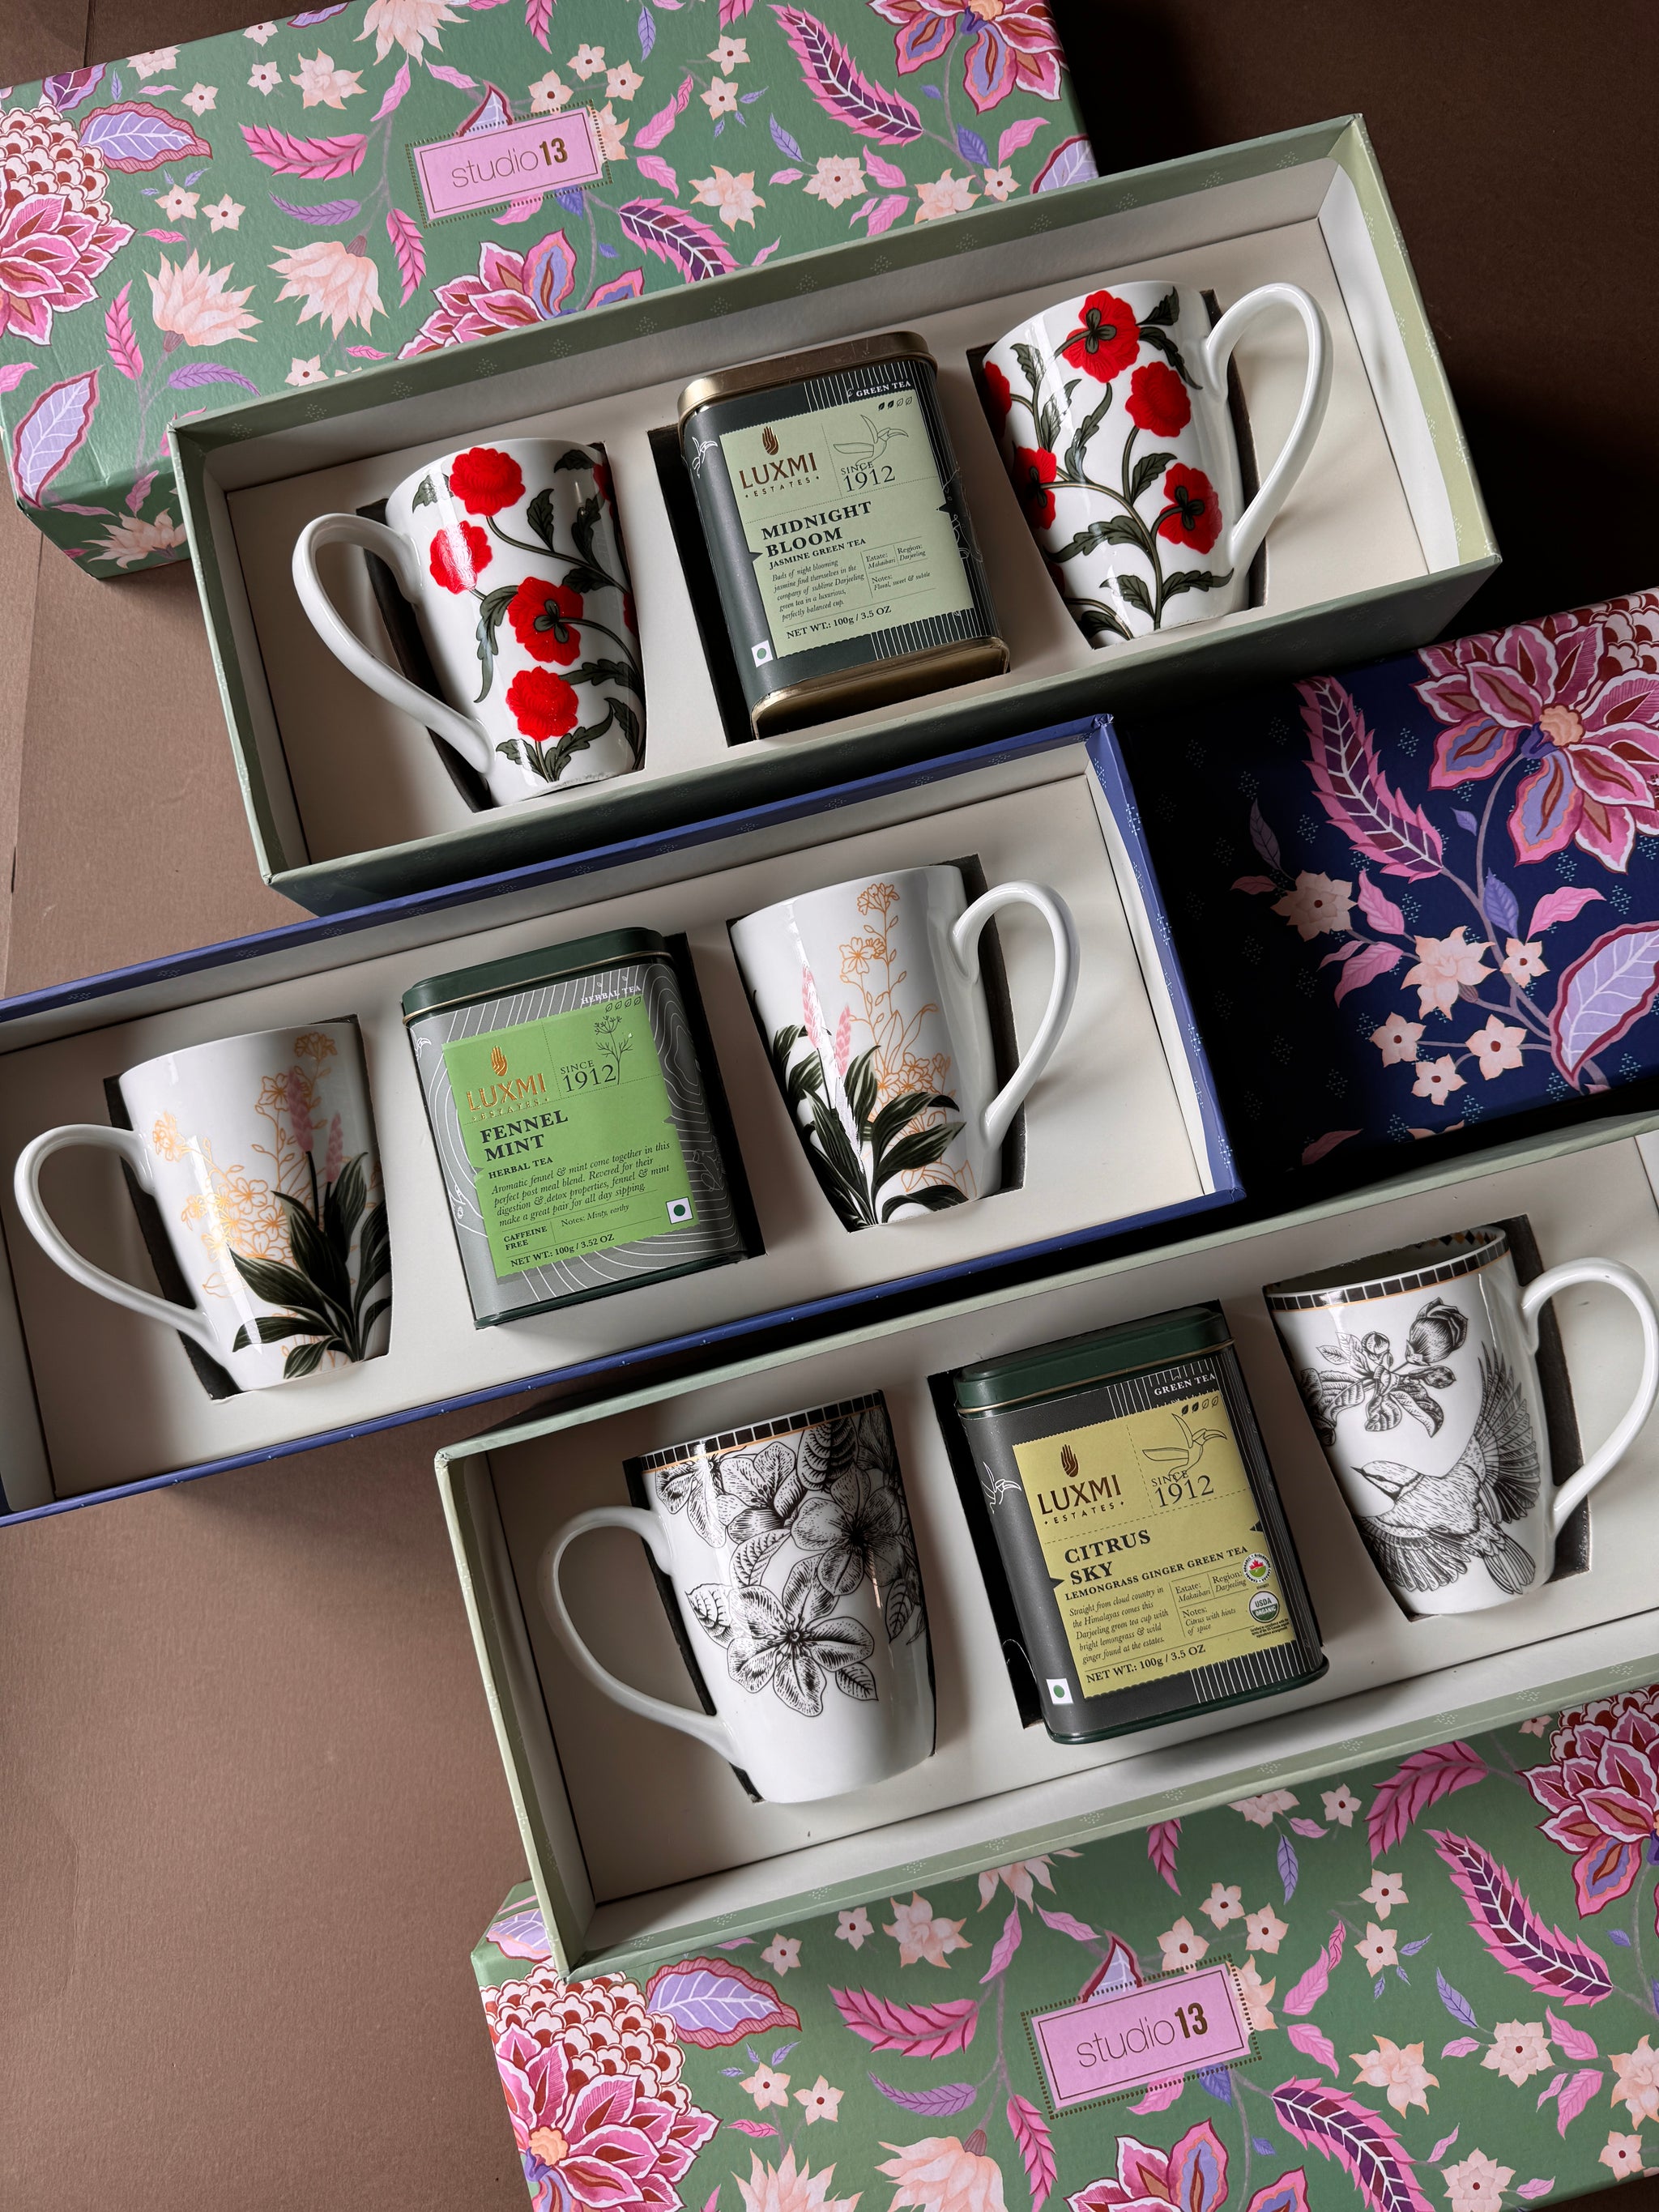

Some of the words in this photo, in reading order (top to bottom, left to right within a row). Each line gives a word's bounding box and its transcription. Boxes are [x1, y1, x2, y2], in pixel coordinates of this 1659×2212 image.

[451, 137, 569, 188] studio13
[855, 384, 889, 397] GREEN
[891, 380, 911, 390] TEA
[739, 452, 817, 489] LUXMI
[840, 461, 874, 475] SINCE
[843, 465, 896, 492] 1912
[753, 476, 811, 497] ESTATES
[761, 501, 872, 540] MIDNIGHT
[765, 526, 843, 558] BLOOM
[769, 552, 811, 570] JASMINE
[812, 543, 845, 557] GREEN
[847, 538, 867, 548] TEA
[897, 544, 923, 555] Region:
[865, 552, 888, 563] Estate:
[868, 558, 896, 569] Makaibari
[899, 550, 927, 561] Darjeeling
[772, 571, 787, 582] Buds
[788, 569, 795, 579] of
[796, 565, 812, 576] night
[812, 560, 839, 571] blooming
[773, 580, 799, 594] jasmine
[795, 575, 809, 588] find
[810, 569, 839, 582] themselves
[847, 564, 857, 573] the
[871, 574, 893, 584] Notes:
[777, 590, 802, 601] company
[803, 585, 810, 596] of
[812, 582, 834, 592] sublime
[834, 573, 865, 586] Darjeeling
[779, 602, 795, 613] green
[782, 607, 805, 623] perfectly
[806, 600, 832, 614] balanced
[786, 626, 808, 639] NET
[809, 621, 831, 633] WT.:
[833, 616, 855, 627] 100g
[855, 613, 859, 622] /
[860, 610, 875, 620] 3.5
[876, 605, 892, 616] OZ
[580, 989, 621, 1006] HERBAL
[621, 984, 642, 995] TEA
[560, 1059, 595, 1075] SINCE
[563, 1064, 616, 1093] 1912
[466, 1072, 547, 1112] LUXMI
[480, 1098, 539, 1120] ESTATES
[480, 1110, 569, 1144] FENNEL
[484, 1133, 544, 1162] MINT
[488, 1162, 531, 1179] HERBAL
[531, 1157, 553, 1167] TEA
[491, 1178, 528, 1196] Aromatic
[528, 1170, 554, 1187] fennel
[556, 1166, 567, 1177] &
[569, 1162, 588, 1174] mint
[590, 1157, 610, 1169] come
[612, 1149, 642, 1164] together
[644, 1145, 653, 1155] in
[655, 1140, 670, 1152] this
[493, 1191, 520, 1208] perfect
[521, 1187, 539, 1201] post
[540, 1179, 560, 1193] meal
[589, 1163, 620, 1180] Revered
[621, 1161, 633, 1175] for
[635, 1156, 654, 1168] their
[497, 1201, 531, 1217] digestion
[533, 1196, 546, 1206] &
[546, 1191, 567, 1204] detox
[609, 1170, 636, 1189] fennel
[638, 1168, 649, 1178] &
[650, 1164, 669, 1175] mint
[499, 1214, 521, 1227] make
[529, 1207, 551, 1221] great
[552, 1201, 569, 1216] pair
[569, 1197, 583, 1211] for
[584, 1192, 596, 1204] all
[598, 1191, 613, 1202] day
[561, 1216, 586, 1227] Notes:
[609, 1203, 629, 1214] earthy
[503, 1225, 548, 1242] CAFFEINE
[505, 1238, 529, 1251] FREE
[510, 1255, 531, 1268] NET
[532, 1251, 553, 1261] WT.:
[555, 1246, 575, 1255] 100g
[576, 1242, 579, 1251] /
[580, 1238, 599, 1249] 3.52
[599, 1233, 615, 1243] OZ
[1154, 1379, 1192, 1396] GREEN
[1193, 1373, 1216, 1384] TEA
[1150, 1468, 1189, 1487] SINCE
[1037, 1474, 1122, 1515] LUXMI
[1154, 1474, 1214, 1508] 1912
[1053, 1502, 1115, 1524] ESTATES
[1064, 1529, 1151, 1564] CITRUS
[1064, 1575, 1139, 1600] LEMONGRASS
[1141, 1563, 1185, 1581] GINGER
[1187, 1551, 1225, 1568] GREEN
[1226, 1545, 1248, 1558] TEA
[1069, 1561, 1113, 1585] SKY
[1212, 1571, 1243, 1584] Region:
[1175, 1583, 1201, 1595] Estate:
[1178, 1587, 1211, 1603] Makaibari
[1215, 1579, 1247, 1593] Darjeeling
[1069, 1603, 1094, 1617] Straight
[1096, 1600, 1112, 1613] from
[1112, 1593, 1130, 1606] cloud
[1131, 1589, 1155, 1601] country
[1073, 1619, 1082, 1629] the
[1084, 1611, 1120, 1626] Himalayas
[1121, 1605, 1141, 1616] comes
[1141, 1600, 1154, 1610] this
[1181, 1606, 1208, 1618] Notes:
[1254, 1597, 1273, 1608] USDA
[1255, 1605, 1277, 1617] ORGANIC
[1076, 1626, 1111, 1640] Darjeeling
[1111, 1622, 1128, 1634] green
[1128, 1618, 1139, 1626] tea
[1140, 1613, 1153, 1624] cup
[1153, 1608, 1169, 1620] with
[1185, 1617, 1205, 1627] Citrus
[1205, 1610, 1220, 1622] with
[1221, 1608, 1236, 1617] hints
[1079, 1639, 1098, 1652] bright
[1099, 1631, 1135, 1646] lemongrass
[1136, 1626, 1145, 1636] &
[1146, 1622, 1162, 1634] wild
[1187, 1626, 1195, 1637] of
[1196, 1623, 1212, 1634] spice
[1082, 1653, 1102, 1665] ginger
[1102, 1645, 1122, 1660] found
[1123, 1644, 1131, 1653] at
[1131, 1641, 1141, 1651] the
[1085, 1669, 1111, 1683] NET
[1112, 1663, 1137, 1676] WT.:
[1139, 1657, 1164, 1669] 100g
[1165, 1653, 1168, 1663] /
[1171, 1649, 1187, 1661] 3.5
[1188, 1643, 1206, 1656] OZ
[1077, 2002, 1209, 2068] studio13
